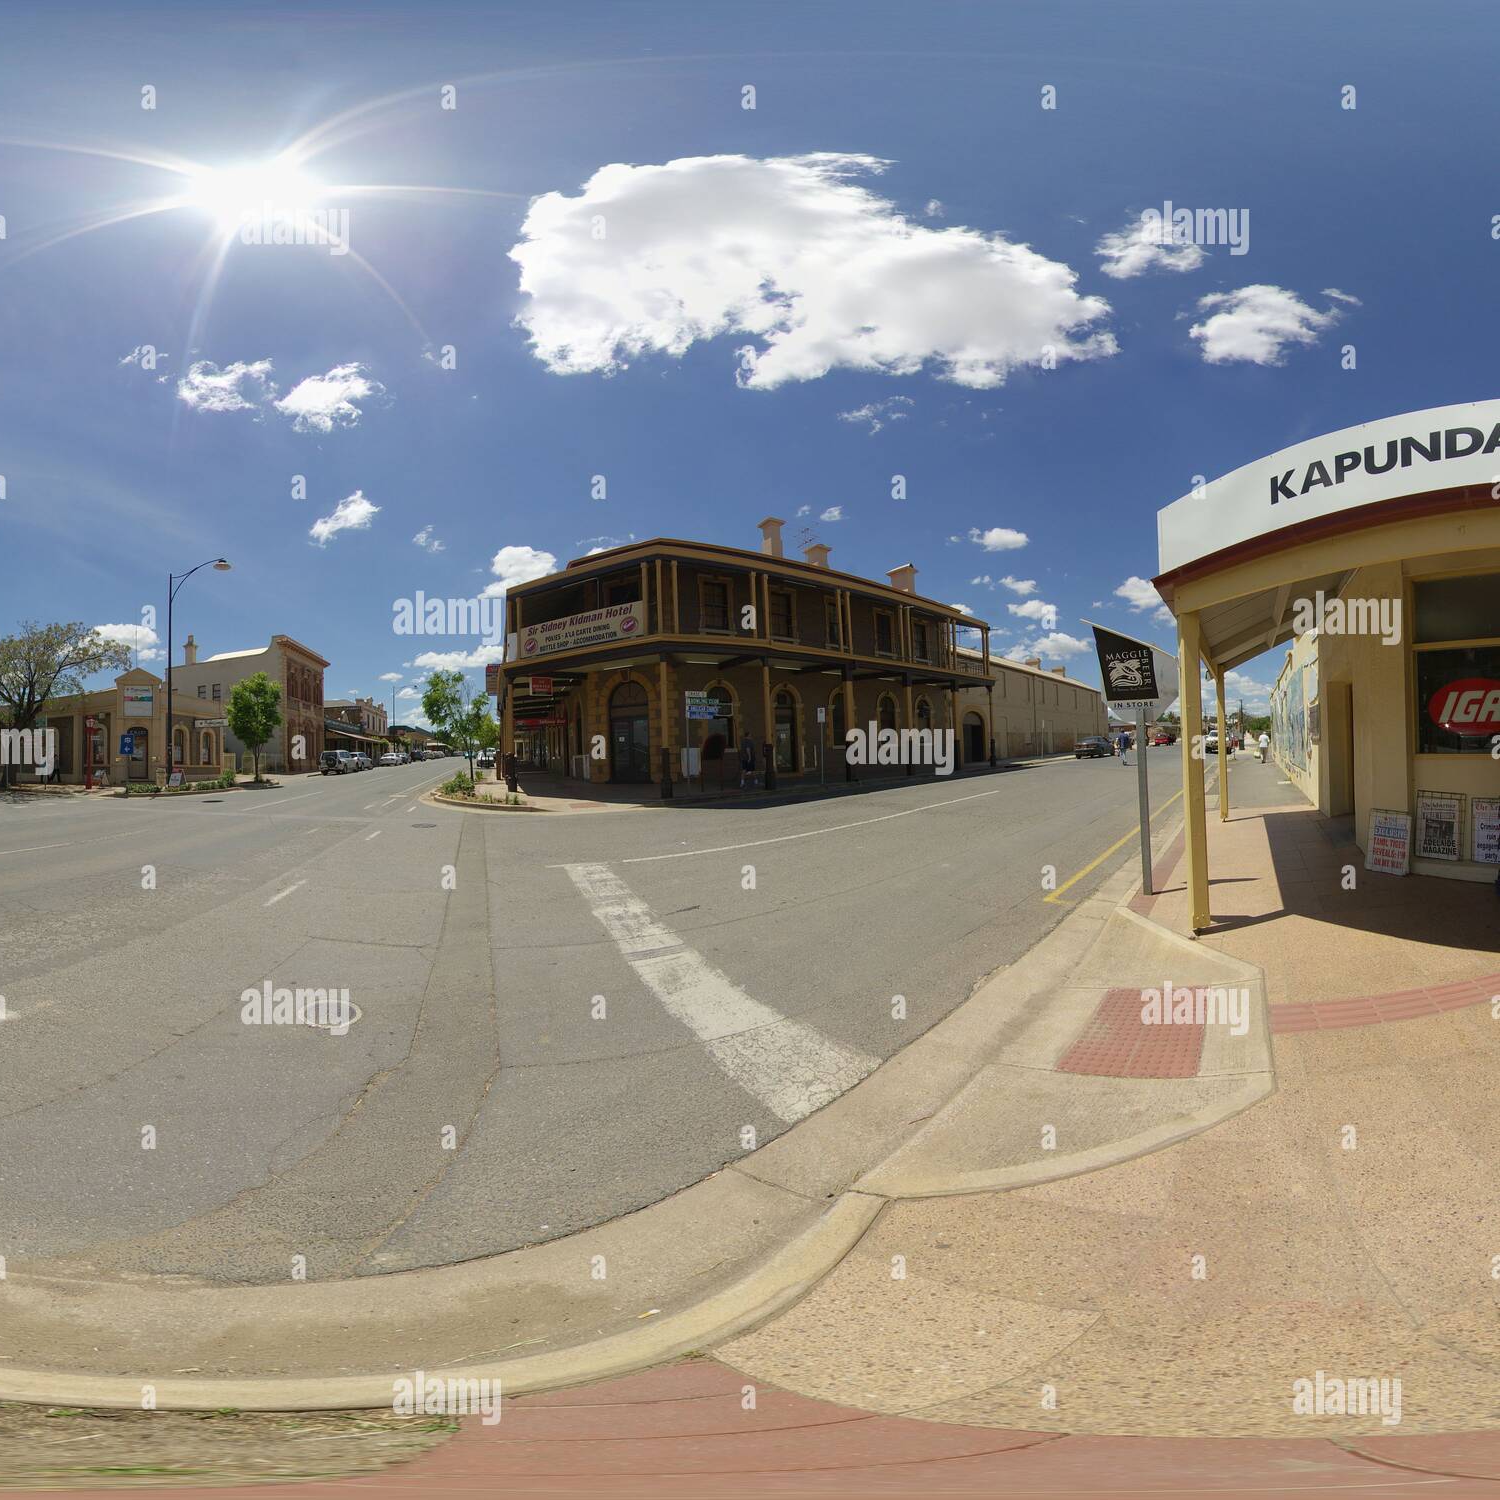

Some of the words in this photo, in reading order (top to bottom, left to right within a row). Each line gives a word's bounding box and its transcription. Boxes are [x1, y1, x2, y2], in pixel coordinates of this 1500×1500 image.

[527, 625, 539, 637] Sir
[540, 619, 568, 634] Sidney
[569, 612, 603, 626] Kidman
[605, 604, 633, 619] Hotel
[1105, 649, 1148, 661] MAGGIE
[1141, 658, 1152, 687] BEER
[1127, 700, 1154, 708] STORE
[1438, 690, 1500, 723] IGA
[1390, 839, 1406, 849] TIGER
[1423, 839, 1456, 848] ADELAIDE
[1422, 846, 1457, 856] MAGAZINE
